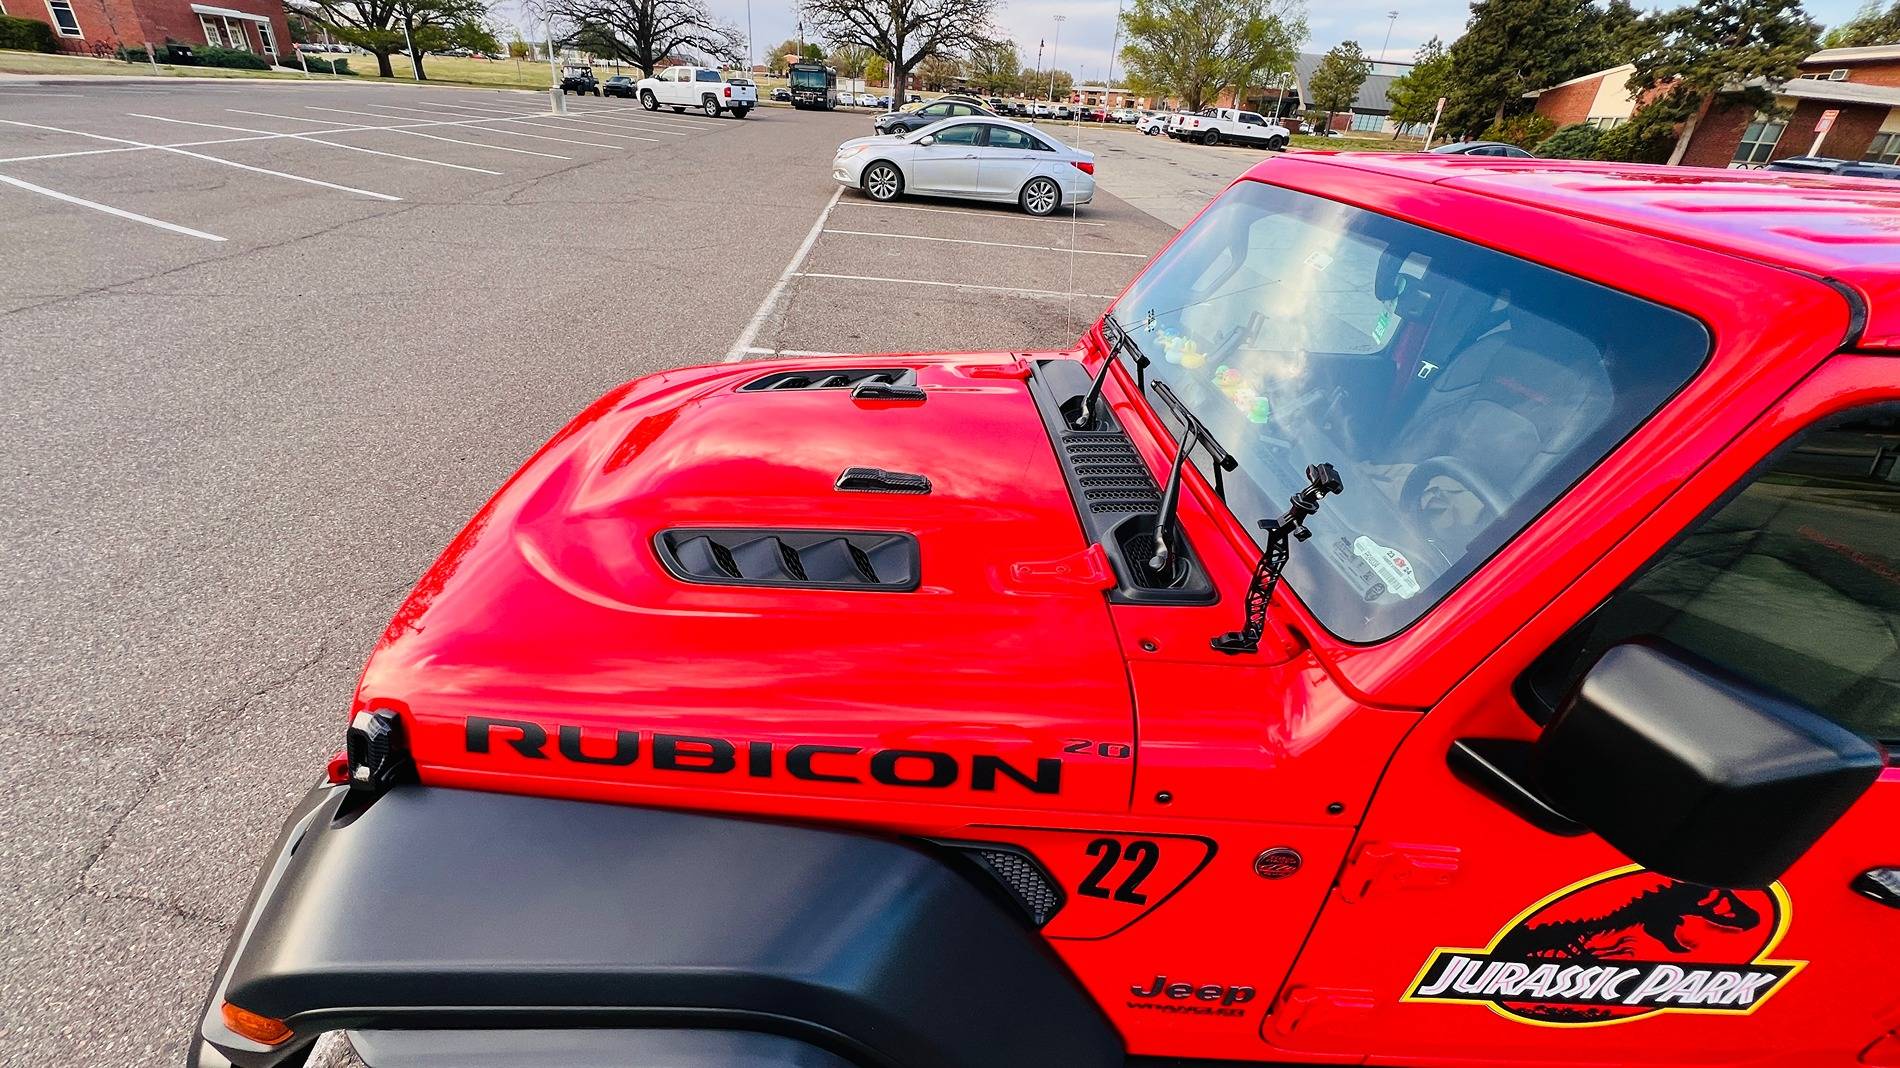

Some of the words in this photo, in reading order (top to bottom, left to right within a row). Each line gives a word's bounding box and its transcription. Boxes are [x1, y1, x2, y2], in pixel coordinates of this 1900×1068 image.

[465, 716, 1062, 795] RUBICON
[1077, 838, 1160, 906] 22
[1130, 975, 1256, 1006] Jeep
[1418, 956, 1639, 1001] JURASSIC
[1623, 964, 1777, 1006] PARK
